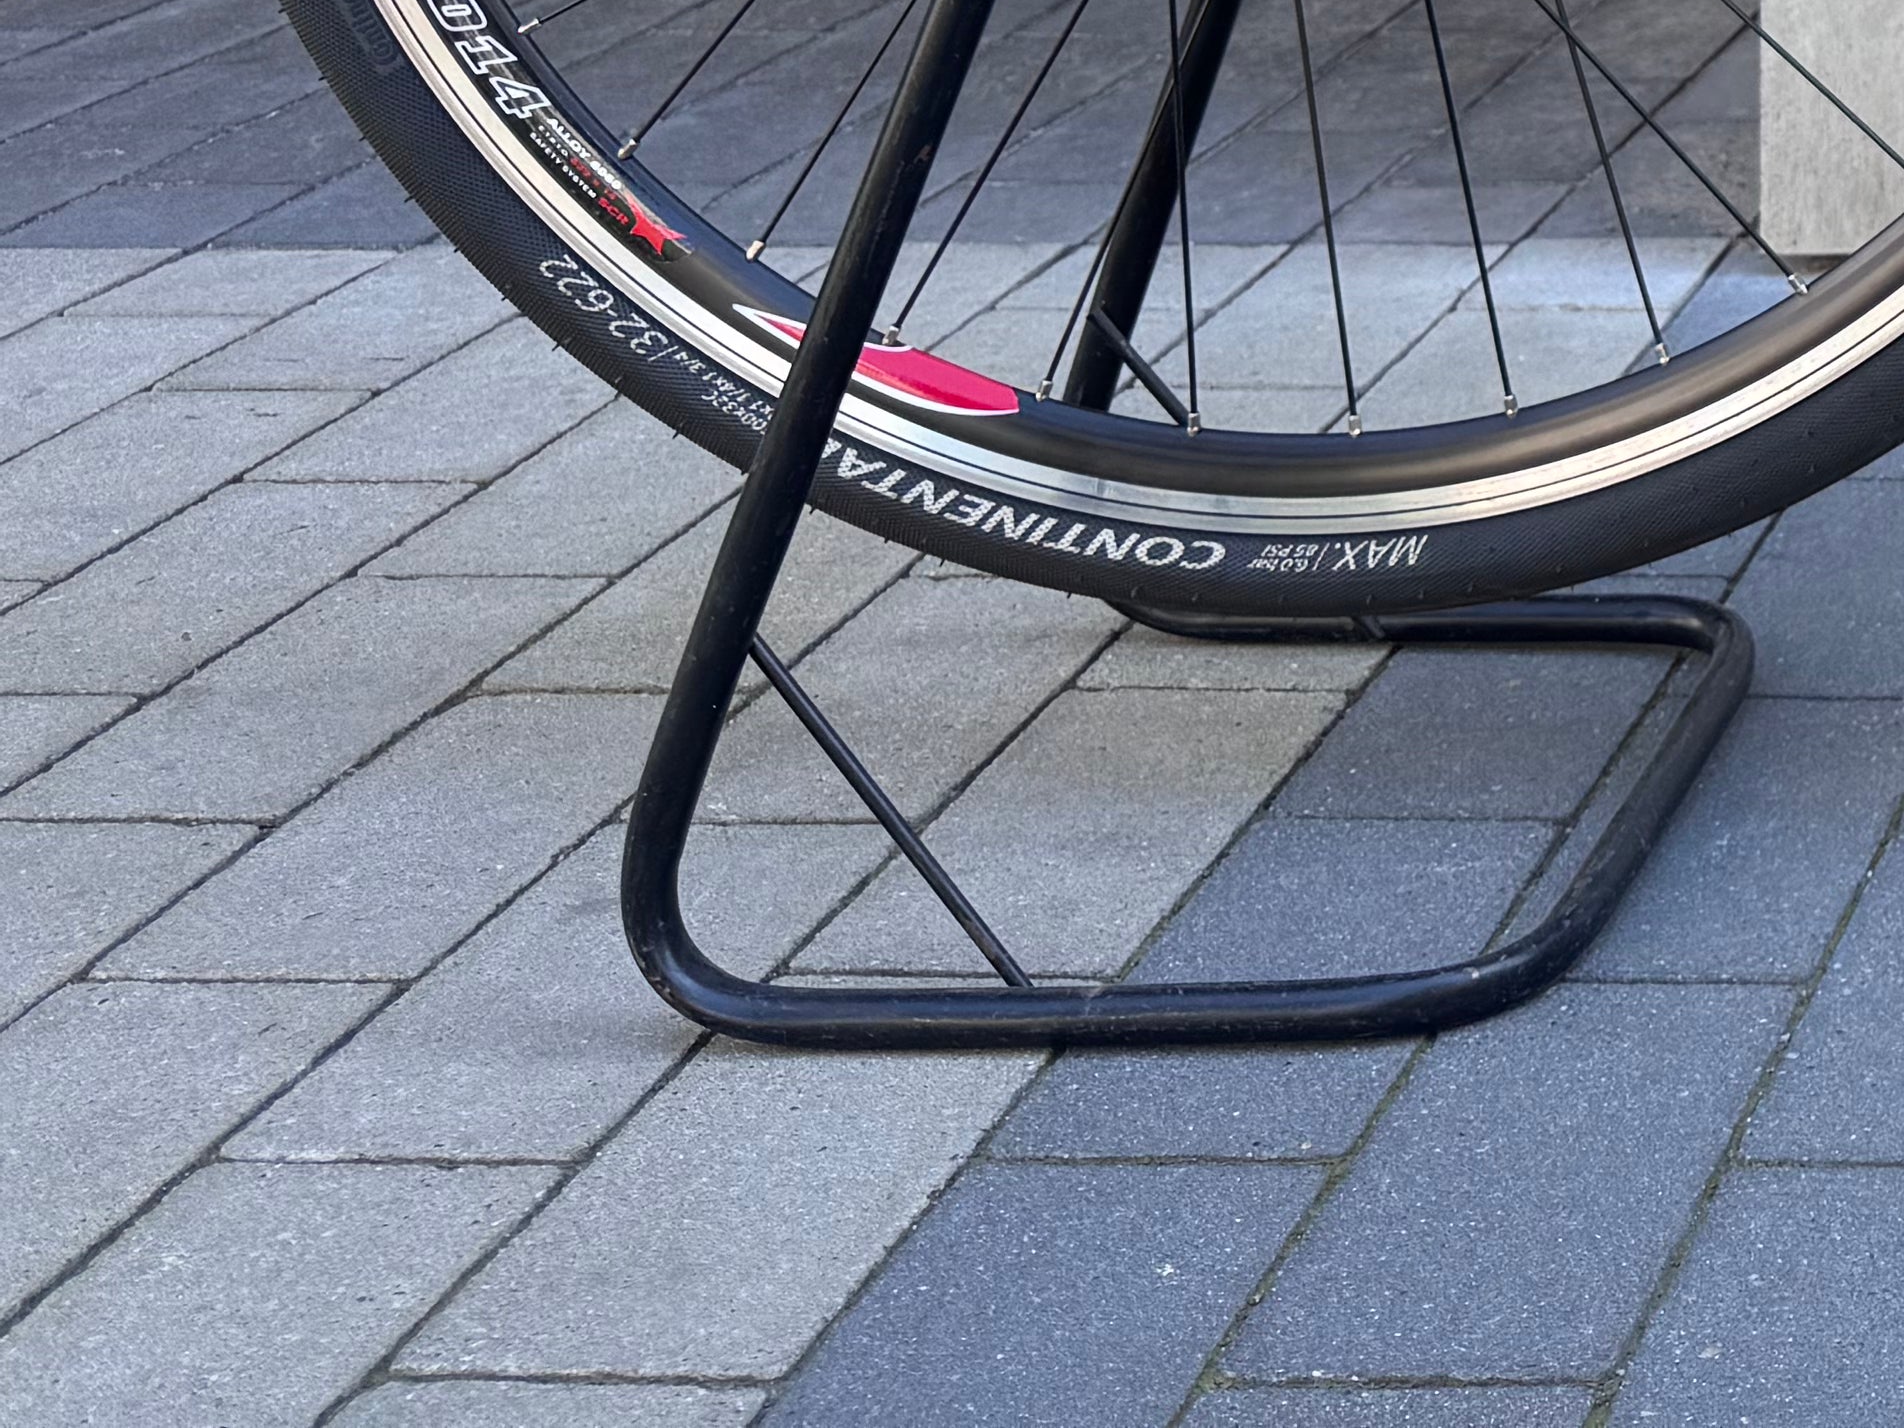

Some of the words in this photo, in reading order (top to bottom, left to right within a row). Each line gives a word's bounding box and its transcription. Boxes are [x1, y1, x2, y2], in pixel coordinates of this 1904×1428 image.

[547, 118, 591, 159] ALLOY
[529, 132, 562, 164] SAFETY
[562, 165, 597, 199] SYSTEM
[538, 254, 669, 355] 32-622
[1260, 543, 1293, 558] PSI
[1331, 534, 1429, 571] MAX.
